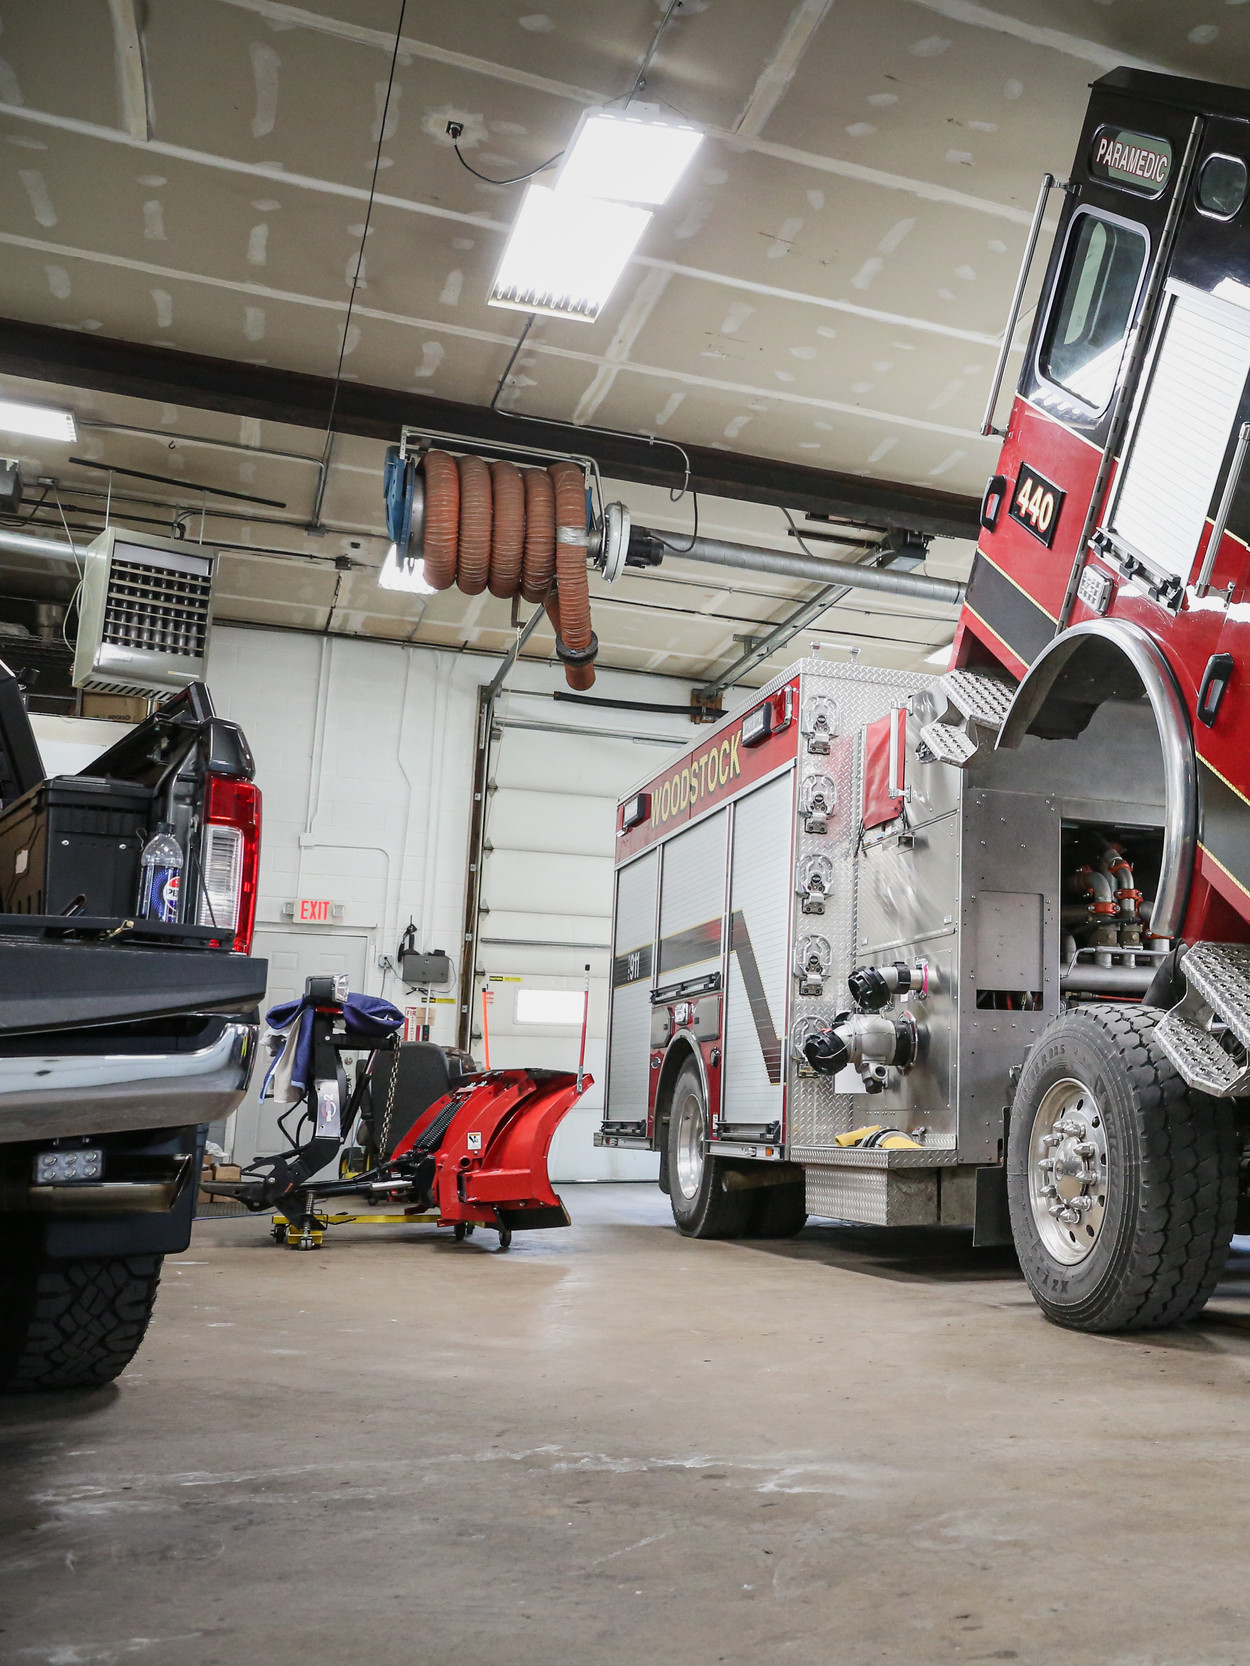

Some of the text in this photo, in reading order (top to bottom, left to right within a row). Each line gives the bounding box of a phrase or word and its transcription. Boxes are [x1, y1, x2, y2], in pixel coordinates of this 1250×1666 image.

[1096, 137, 1168, 183] PARAMEDIC
[1016, 477, 1054, 533] 440
[651, 729, 742, 828] WOODSTOCK
[300, 900, 330, 921] EXIT
[629, 952, 640, 980] 911
